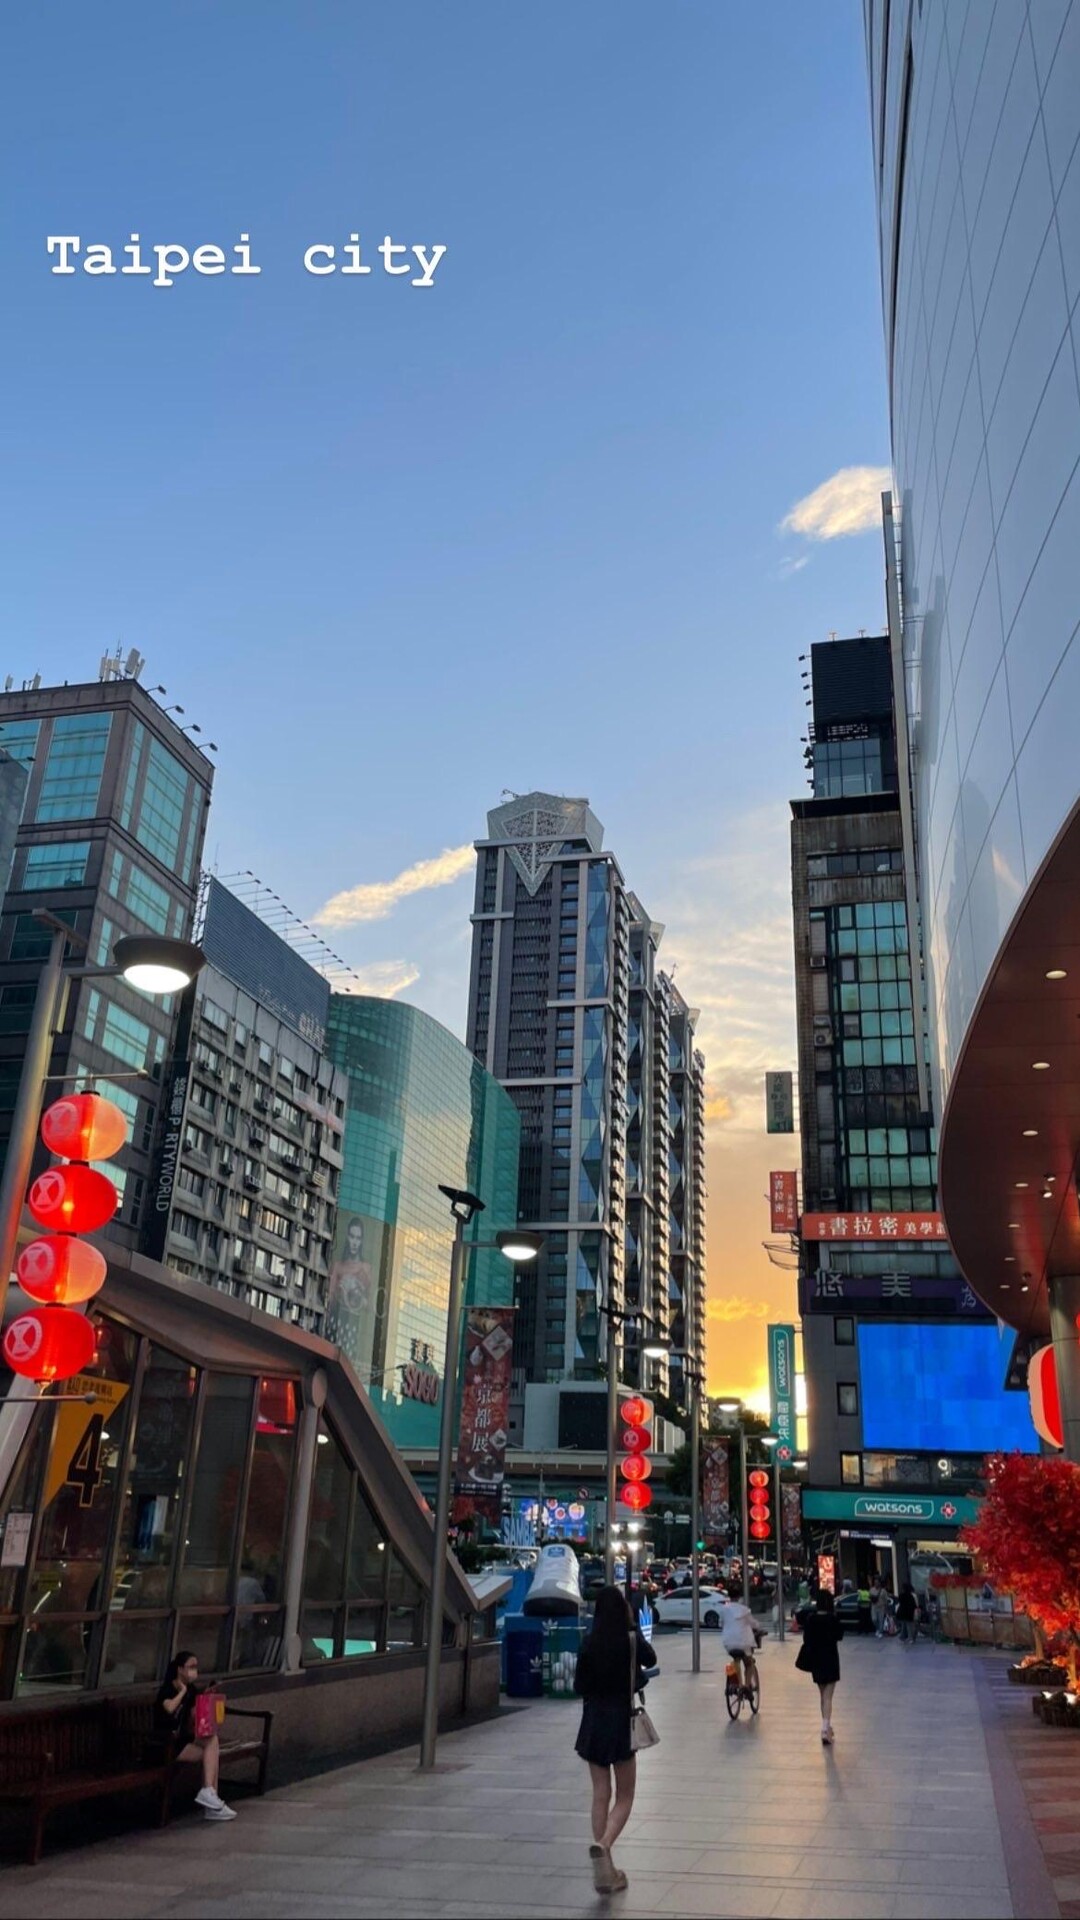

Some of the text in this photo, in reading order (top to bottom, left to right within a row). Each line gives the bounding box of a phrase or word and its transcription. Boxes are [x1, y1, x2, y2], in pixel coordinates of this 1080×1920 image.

[829, 1216, 899, 1236] 書拉密
[404, 1361, 439, 1404] SOGO
[777, 1338, 785, 1388] watsons
[472, 1385, 492, 1453] 京都展
[65, 1412, 104, 1508] 4
[865, 1502, 923, 1515] watsons
